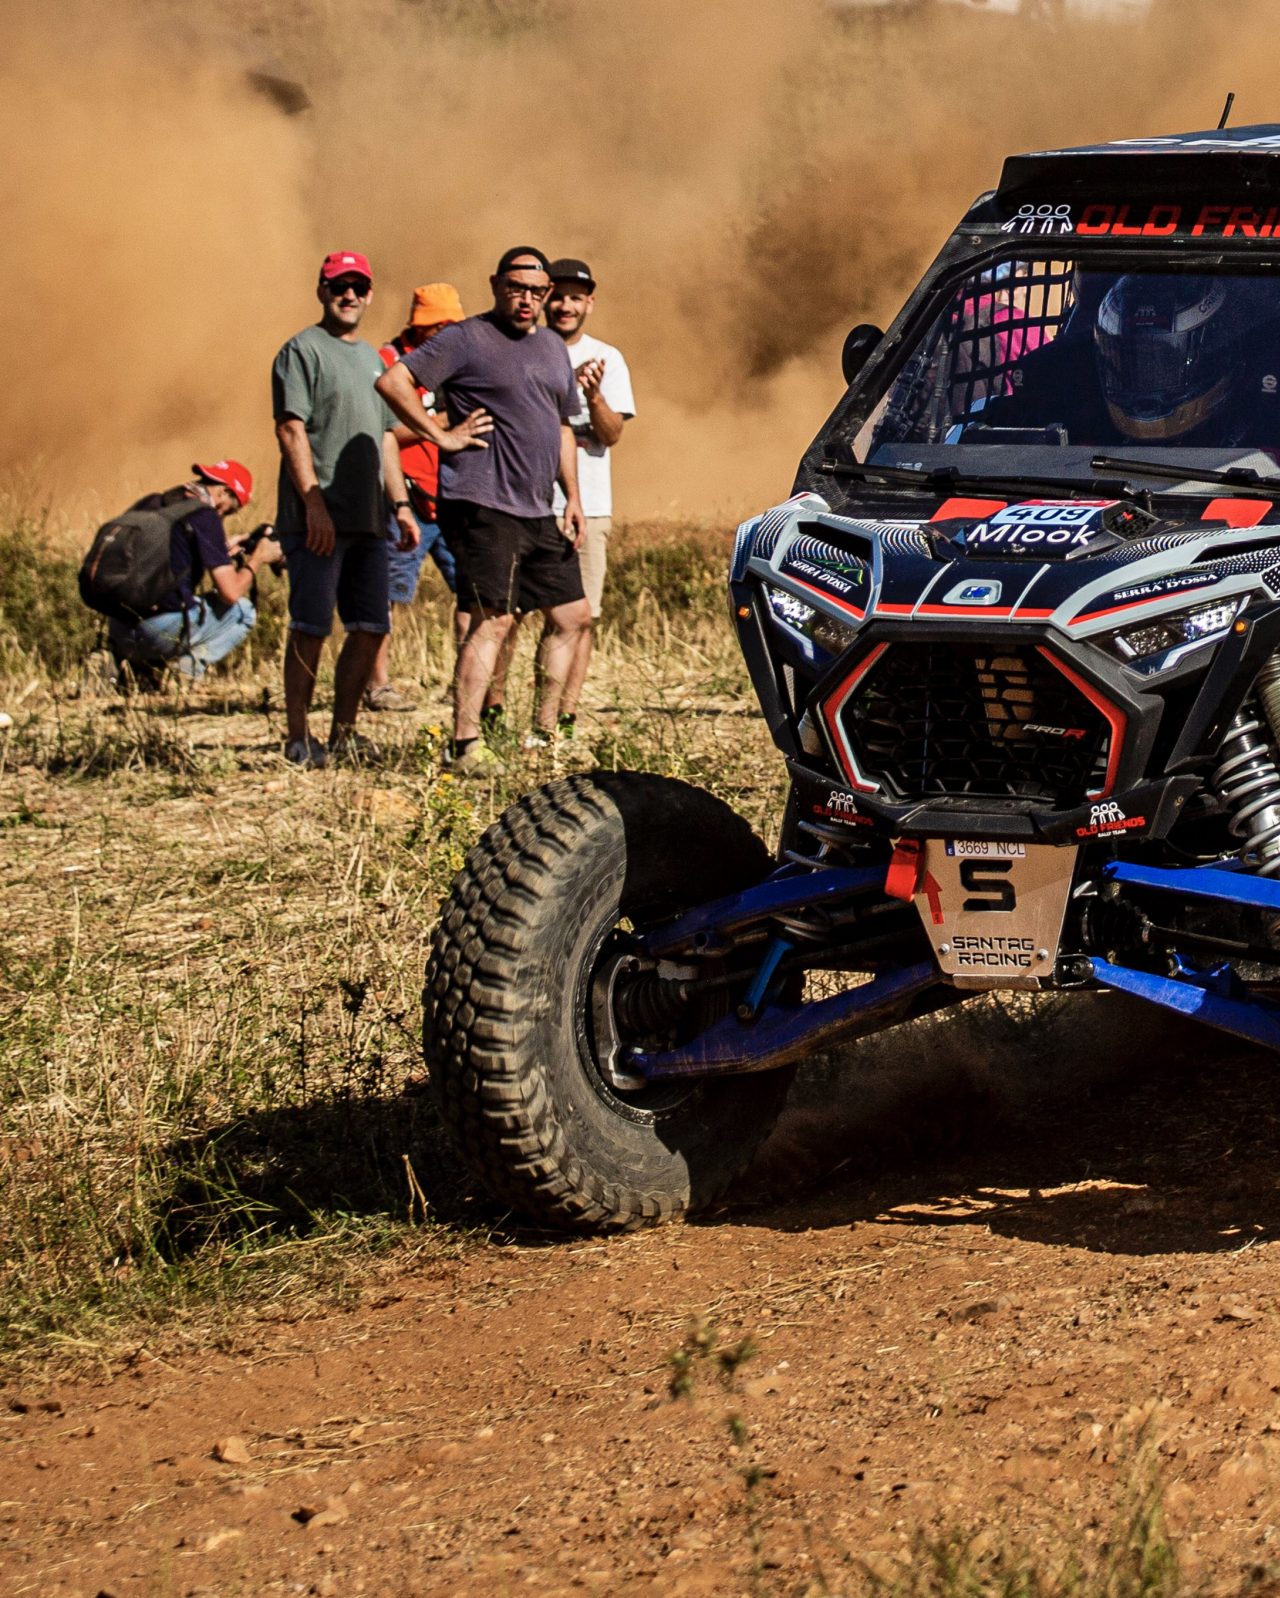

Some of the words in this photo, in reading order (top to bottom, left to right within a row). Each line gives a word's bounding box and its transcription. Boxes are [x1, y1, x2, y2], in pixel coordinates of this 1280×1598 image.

[1076, 204, 1181, 236] OLD
[1005, 507, 1093, 523] 409
[967, 524, 1096, 546] Mlook
[789, 560, 821, 577] SERRA
[1114, 584, 1162, 600] SERRA
[1166, 574, 1218, 588] D'OSSA
[1076, 825, 1098, 837] OLD
[1100, 816, 1146, 832] FRIENDS
[958, 840, 989, 855] 3669
[996, 842, 1025, 856] NCL
[952, 936, 1034, 951] SANTAG
[958, 952, 1032, 967] RACING
